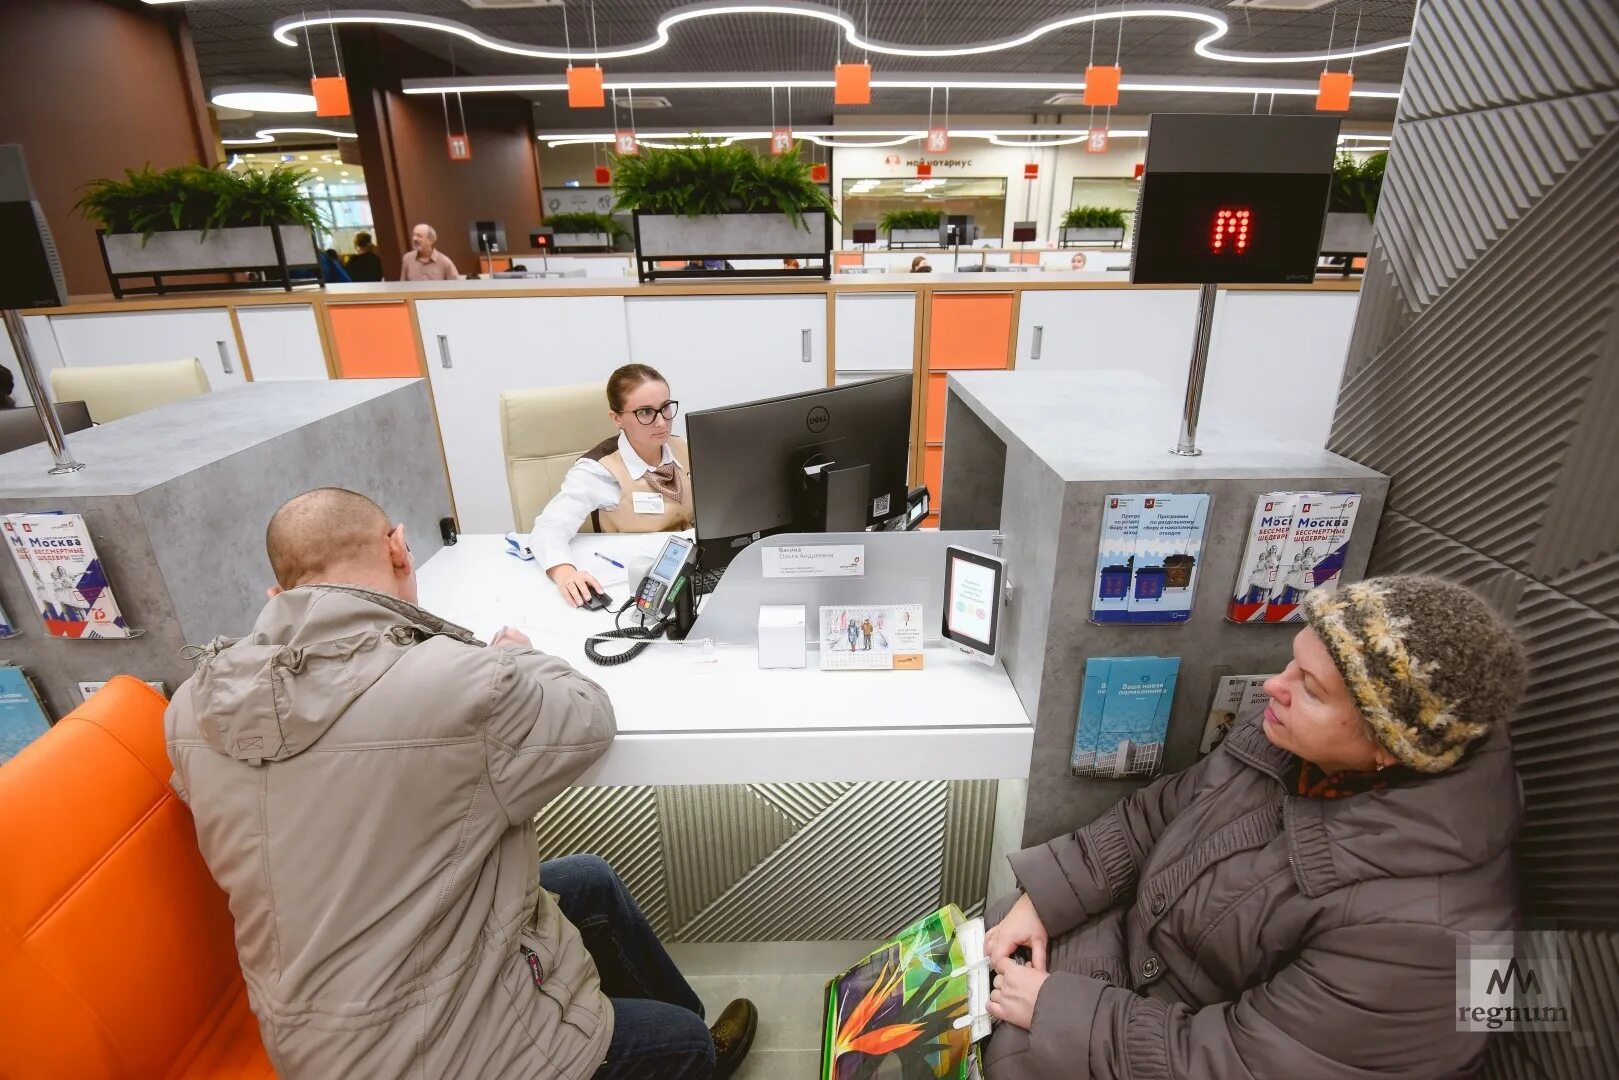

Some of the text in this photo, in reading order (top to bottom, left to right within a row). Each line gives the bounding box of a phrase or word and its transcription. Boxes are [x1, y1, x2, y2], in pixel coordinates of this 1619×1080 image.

[619, 136, 634, 152] 12
[1091, 133, 1105, 149] 15
[452, 140, 466, 156] 11
[810, 416, 827, 425] DELL
[1298, 518, 1348, 528] Москва
[28, 538, 82, 547] Москва
